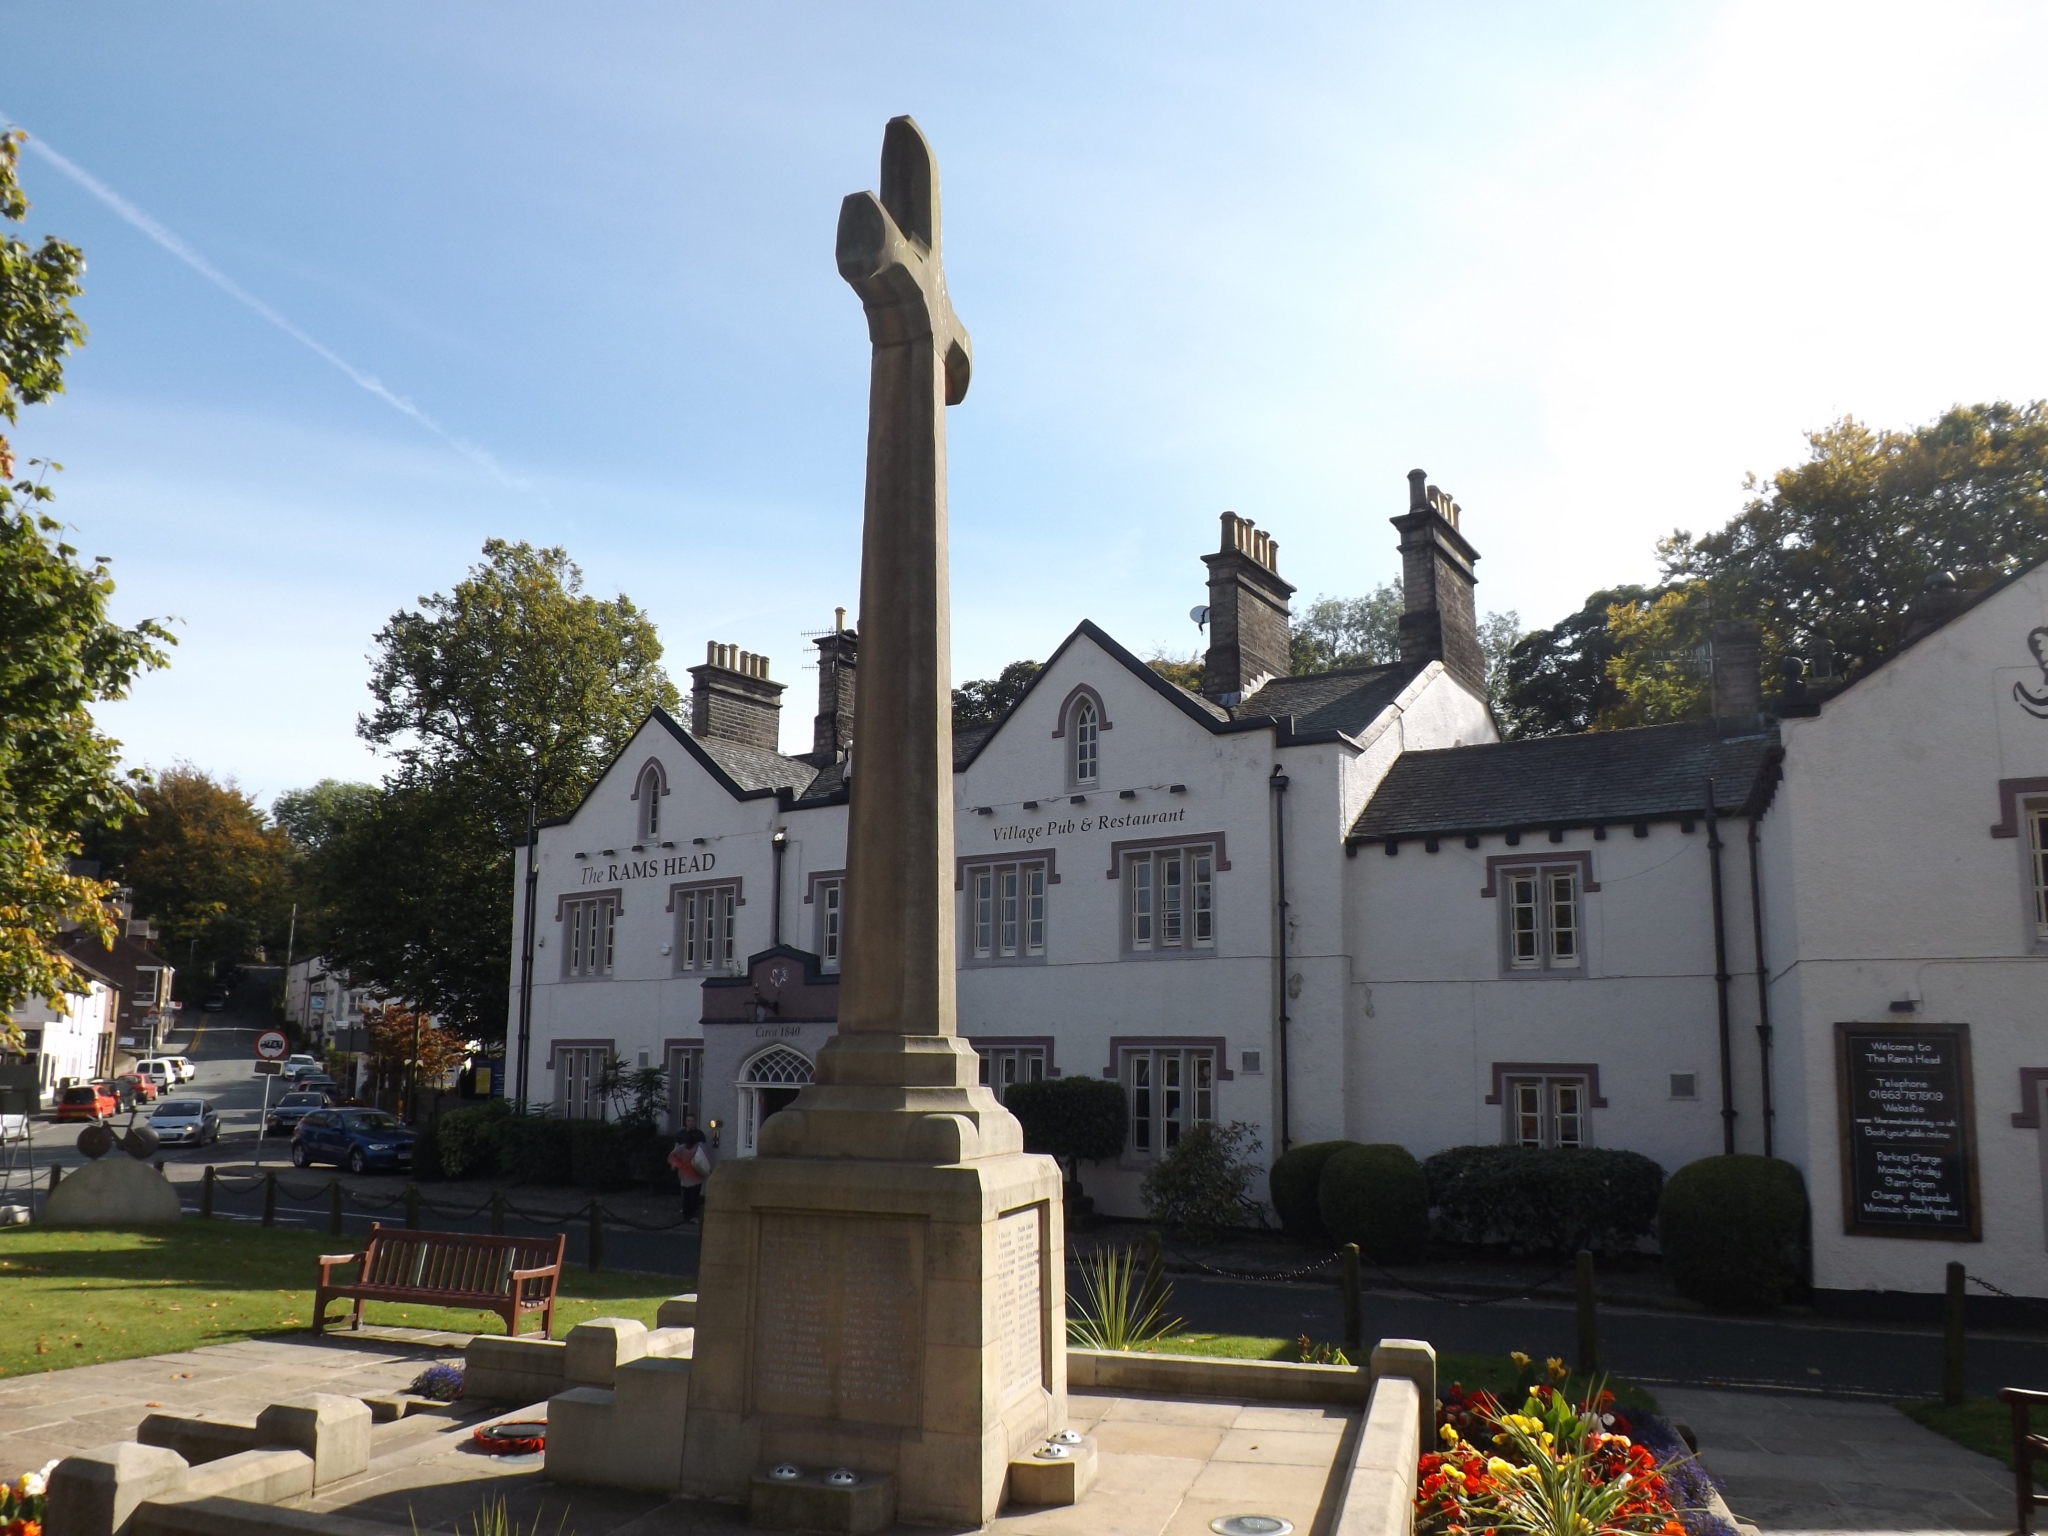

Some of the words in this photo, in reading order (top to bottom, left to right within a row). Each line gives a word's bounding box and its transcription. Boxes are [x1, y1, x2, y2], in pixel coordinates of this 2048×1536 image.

[993, 825, 1042, 843] Village
[1047, 819, 1075, 836] Pub
[1080, 818, 1093, 831] &
[1098, 808, 1185, 830] Restaurant
[581, 866, 604, 885] The
[608, 859, 658, 882] RAMS
[663, 853, 716, 876] HEAD
[755, 1026, 778, 1038] Circa
[780, 1026, 801, 1037] 1840
[1871, 1042, 1915, 1051] Welcome
[1917, 1043, 1932, 1052] to
[1865, 1053, 1886, 1063] The
[1887, 1053, 1913, 1064] Ram's
[1915, 1054, 1941, 1064] Head
[1875, 1078, 1928, 1092] Telephone
[1869, 1089, 1901, 1100] 01663
[1882, 1103, 1925, 1113] Website
[1864, 1126, 1887, 1136] Book
[1926, 1130, 1950, 1139] online
[1876, 1151, 1910, 1165] Parking
[1910, 1153, 1942, 1166] Charge
[1871, 1190, 1905, 1203] Charge
[1863, 1202, 1902, 1213] Minimum
